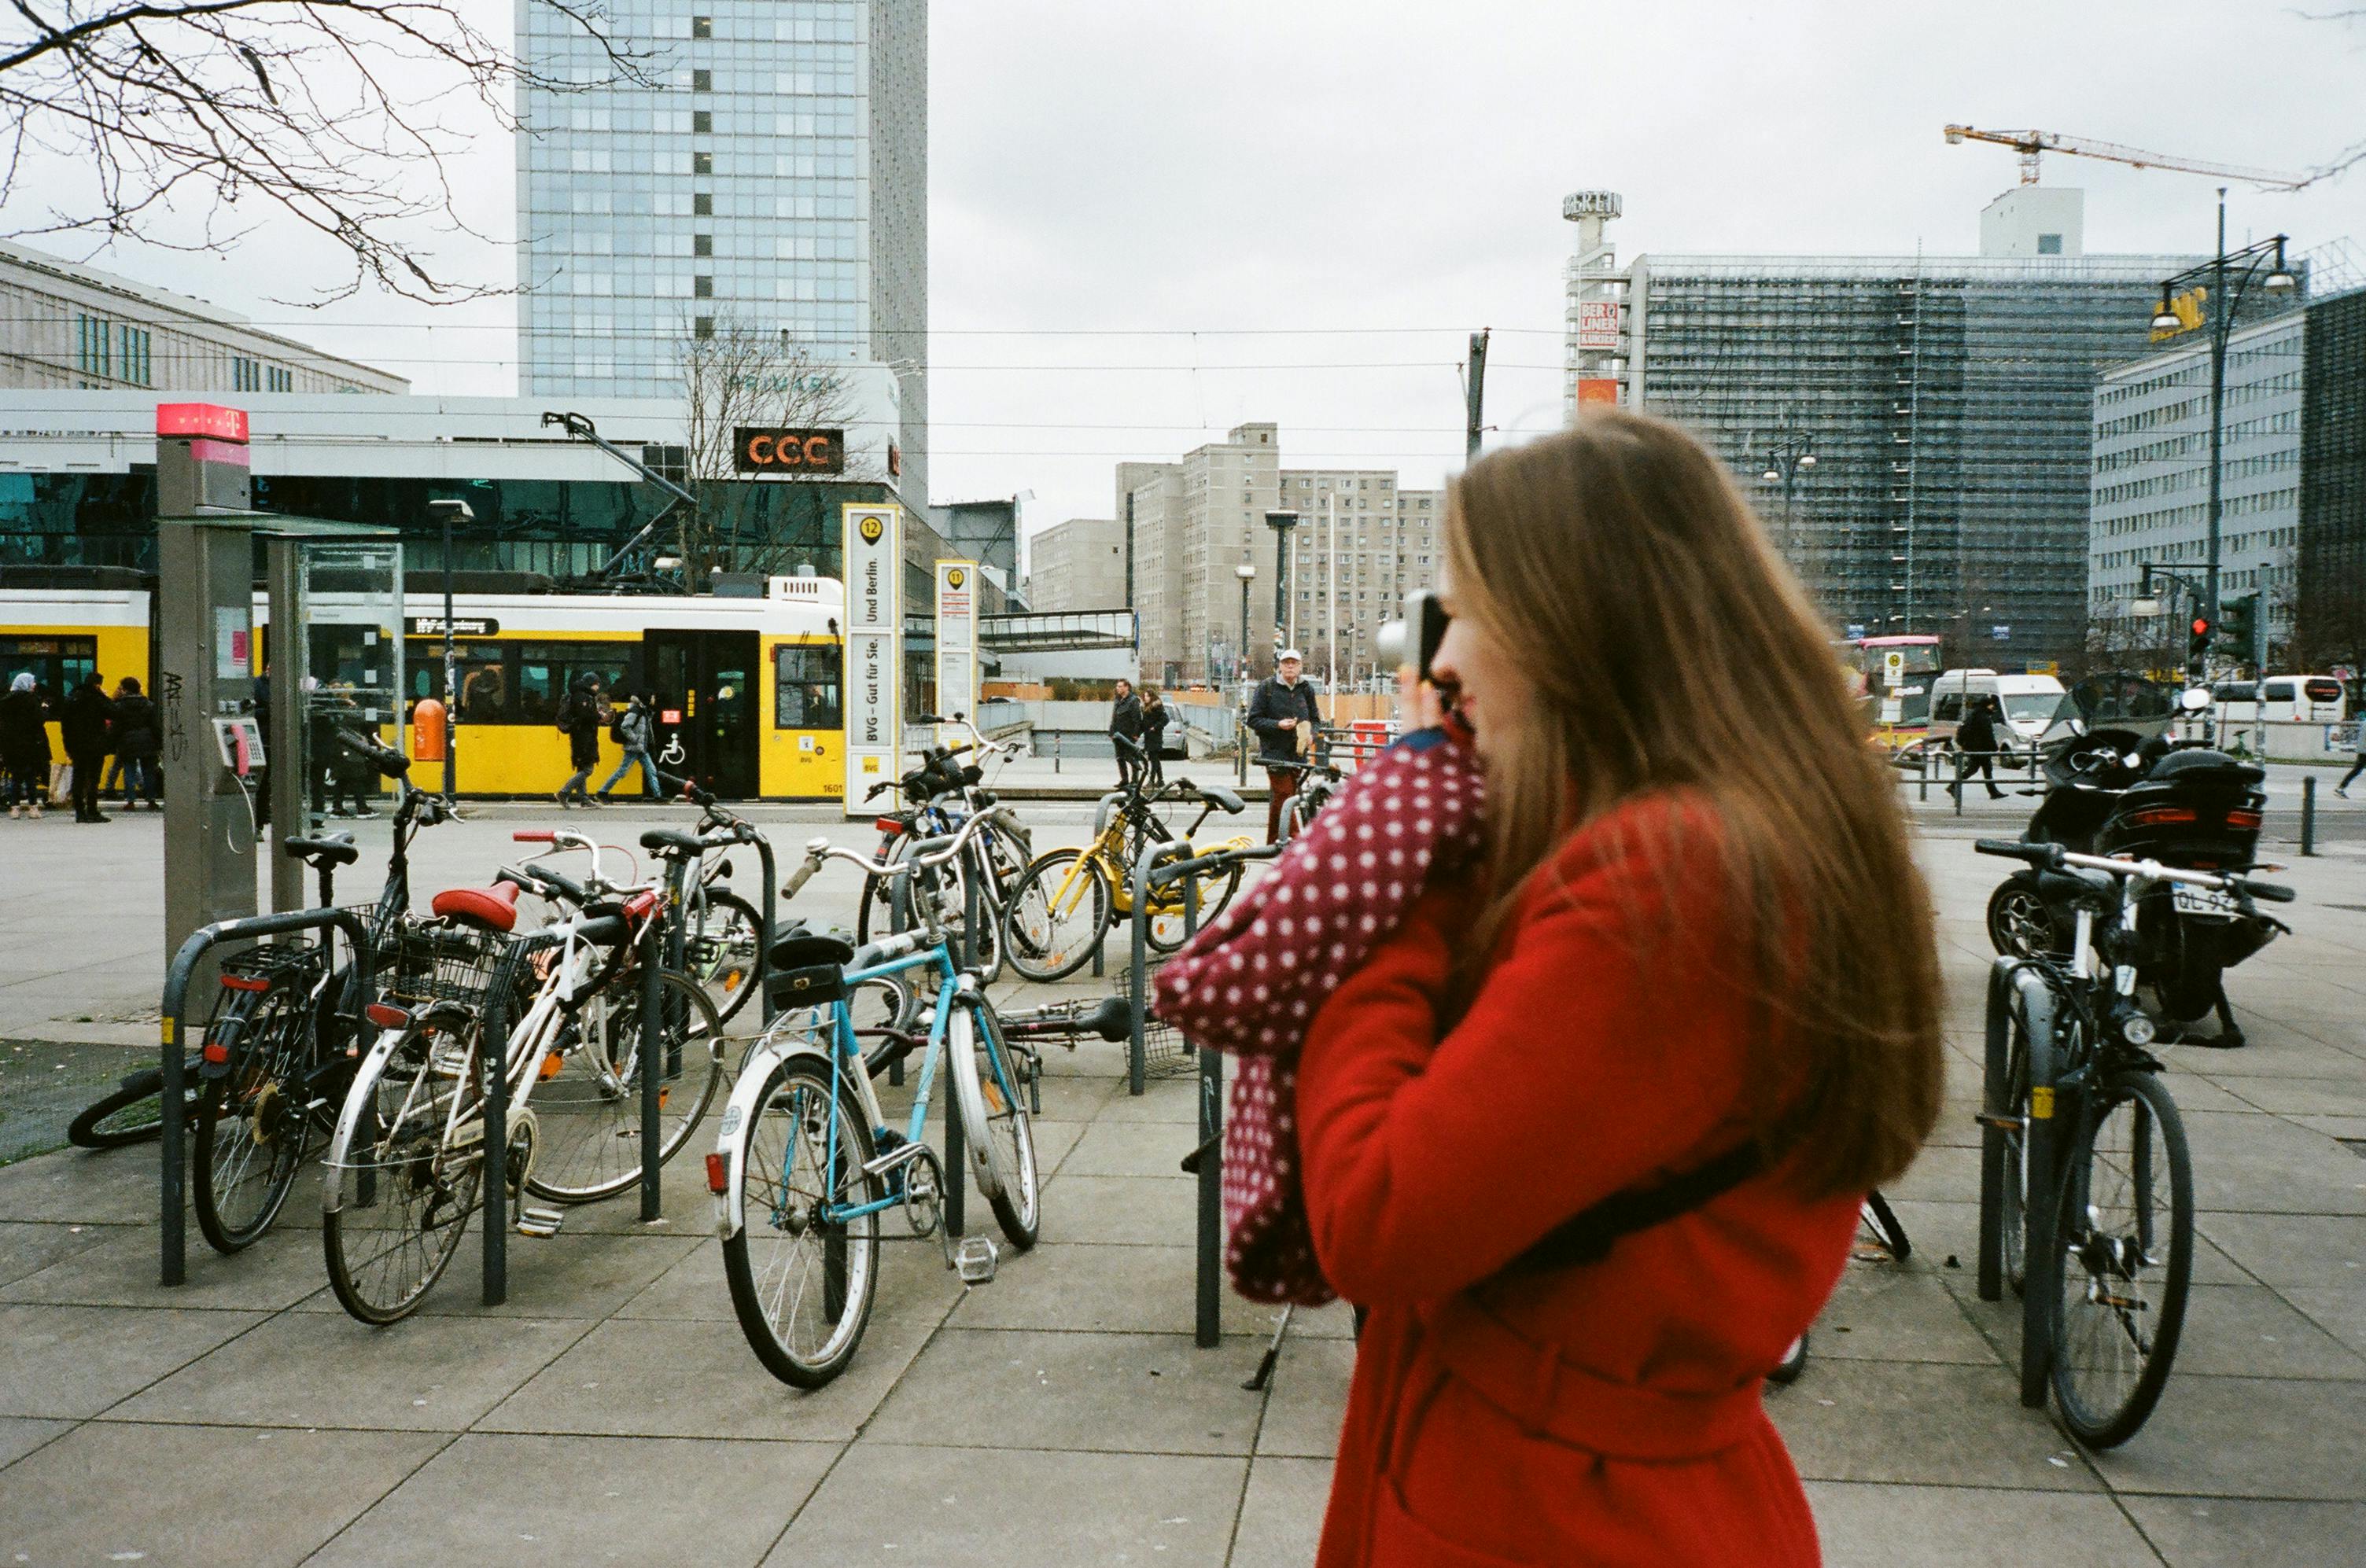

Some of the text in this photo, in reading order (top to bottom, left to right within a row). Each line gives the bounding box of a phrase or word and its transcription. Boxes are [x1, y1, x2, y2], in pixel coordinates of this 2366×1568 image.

[748, 435, 829, 465] CCC
[865, 522, 878, 534] 12
[952, 572, 960, 582] 11
[865, 558, 877, 622] Und Berlin.
[866, 639, 878, 659] Sie.
[866, 664, 878, 679] für
[866, 683, 878, 705] Gut
[866, 717, 878, 742] BVG
